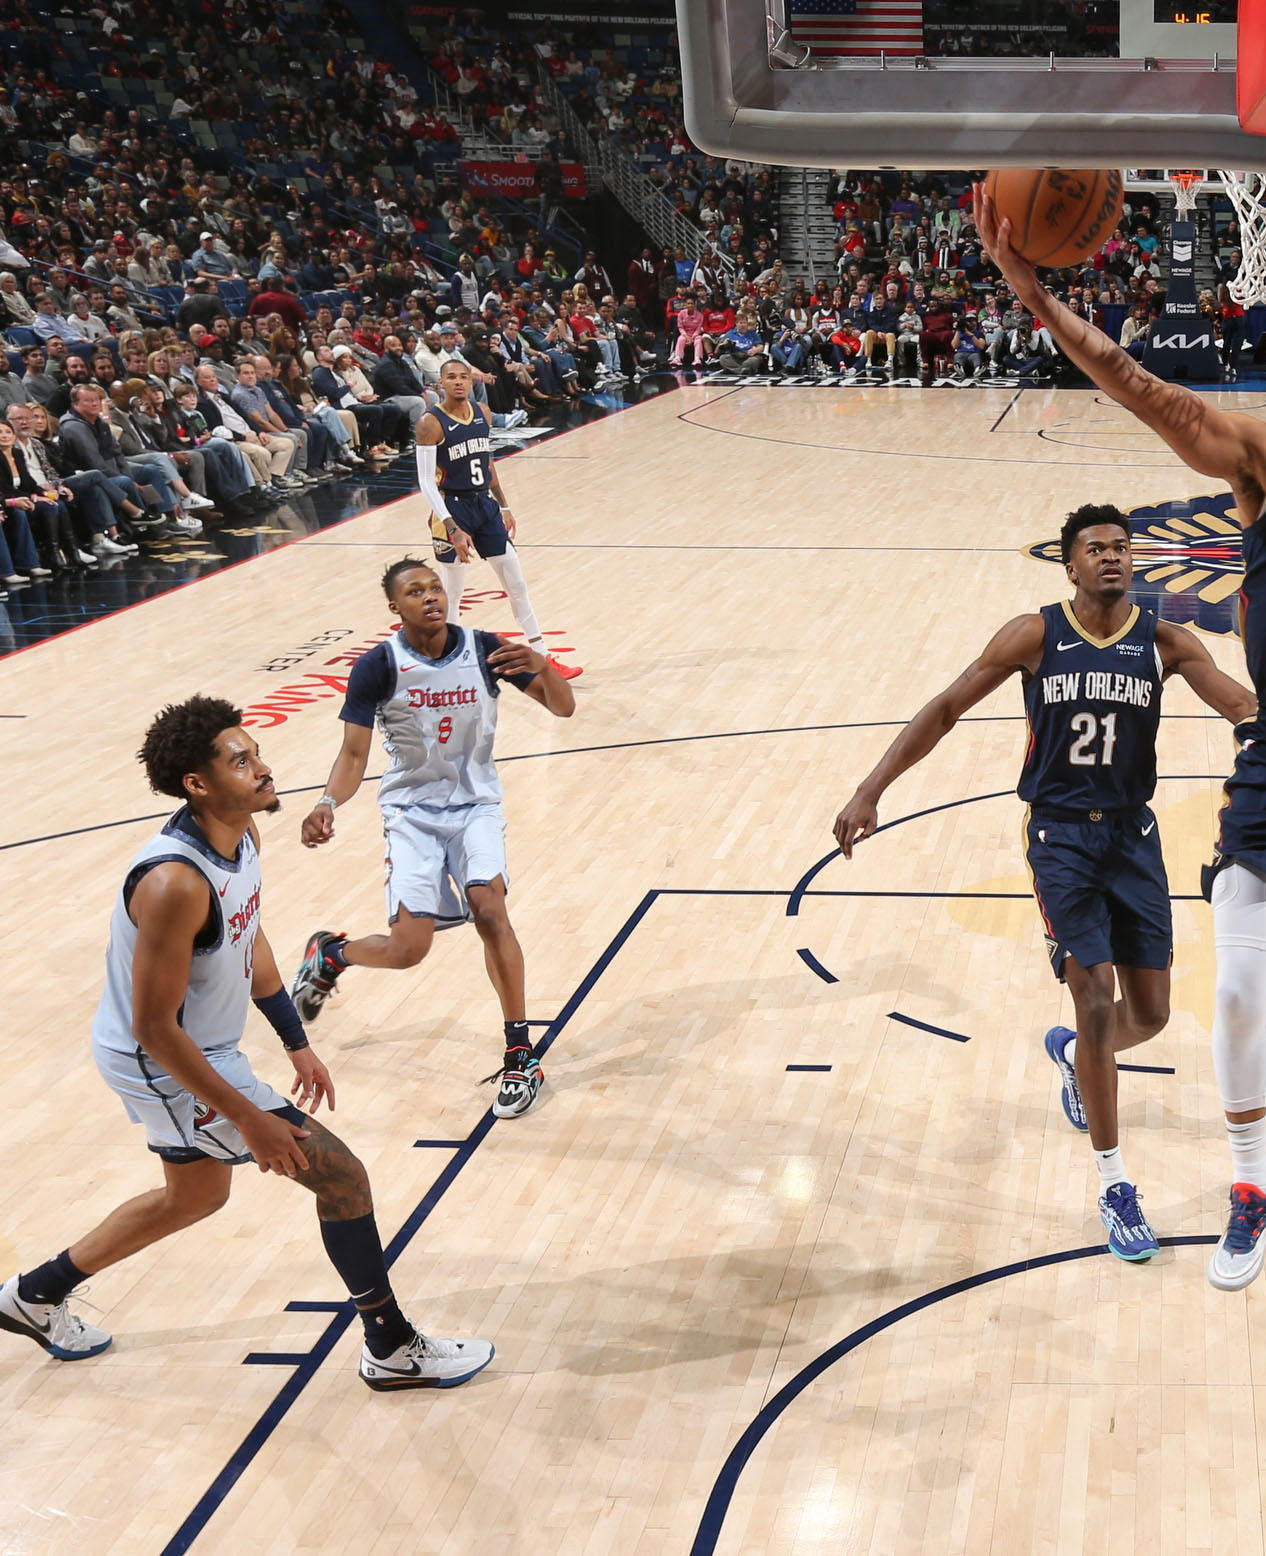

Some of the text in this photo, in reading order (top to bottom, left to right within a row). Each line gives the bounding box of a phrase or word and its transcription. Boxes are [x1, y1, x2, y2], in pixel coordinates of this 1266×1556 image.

[491, 173, 535, 187] SMOOT
[1153, 334, 1209, 349] KIA
[691, 376, 1021, 388] PELICANS
[448, 441, 468, 461] NEW
[470, 459, 485, 486] 5
[253, 628, 354, 673] CENTER
[1115, 643, 1145, 652] NEWAGE
[407, 684, 478, 709] District
[1042, 671, 1153, 708] NEW ORLEANS
[438, 716, 453, 744] 8
[1069, 712, 1118, 766] 21
